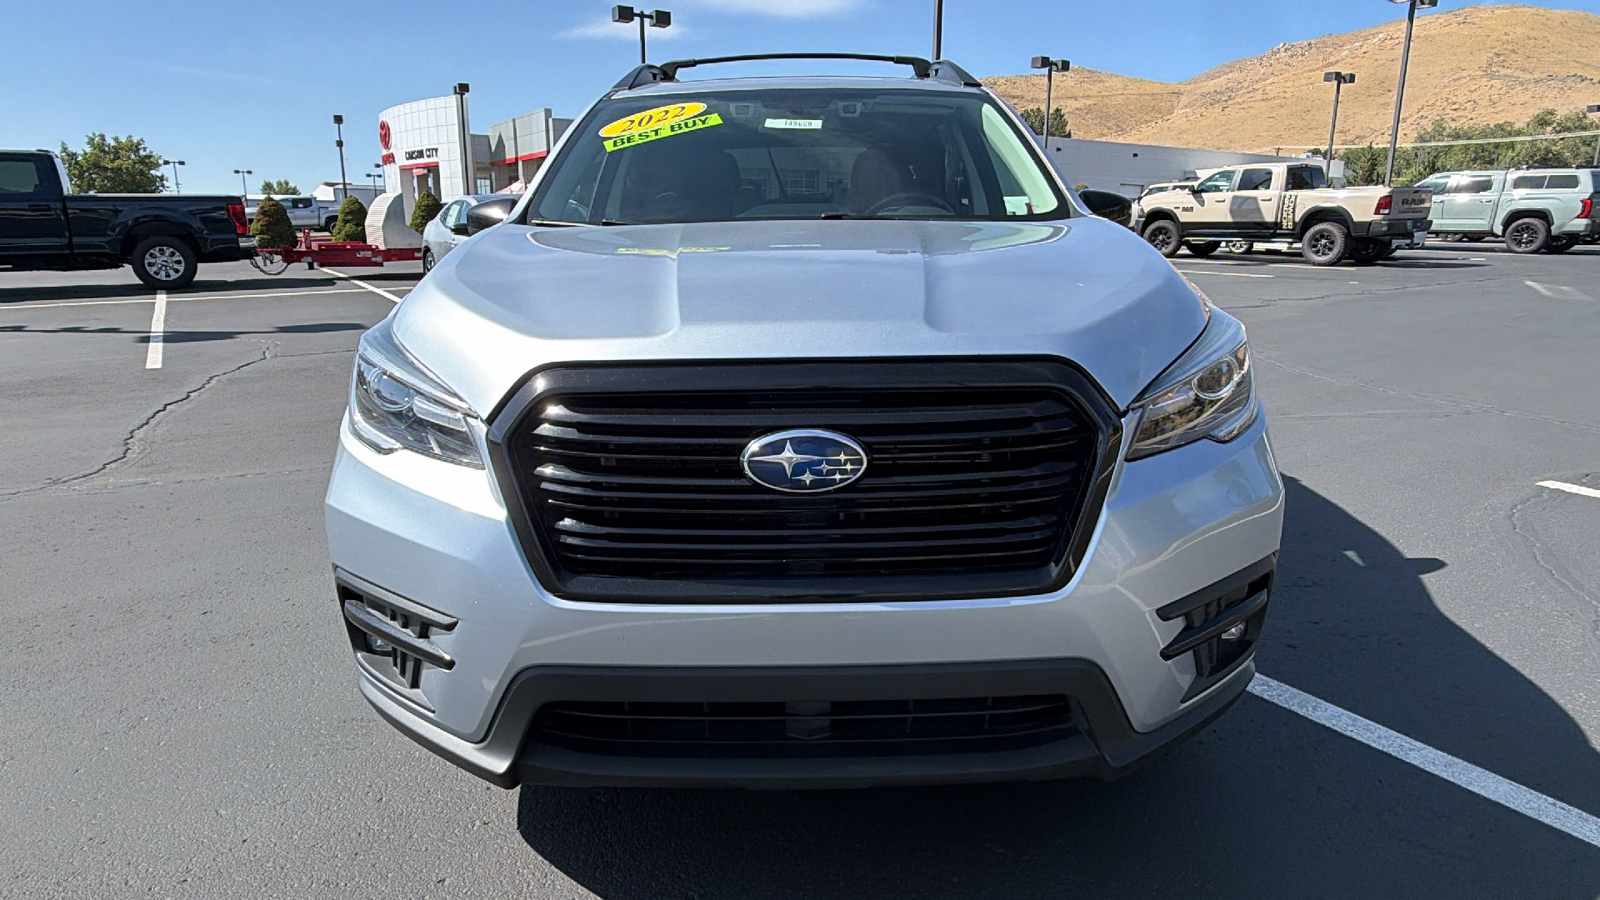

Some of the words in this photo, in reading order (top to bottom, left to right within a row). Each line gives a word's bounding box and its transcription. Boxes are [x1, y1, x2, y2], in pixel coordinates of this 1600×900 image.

[619, 106, 687, 134] 2022
[613, 128, 663, 148] BEST
[669, 117, 711, 133] BUY
[425, 148, 438, 158] CITY
[1401, 198, 1426, 206] RAM
